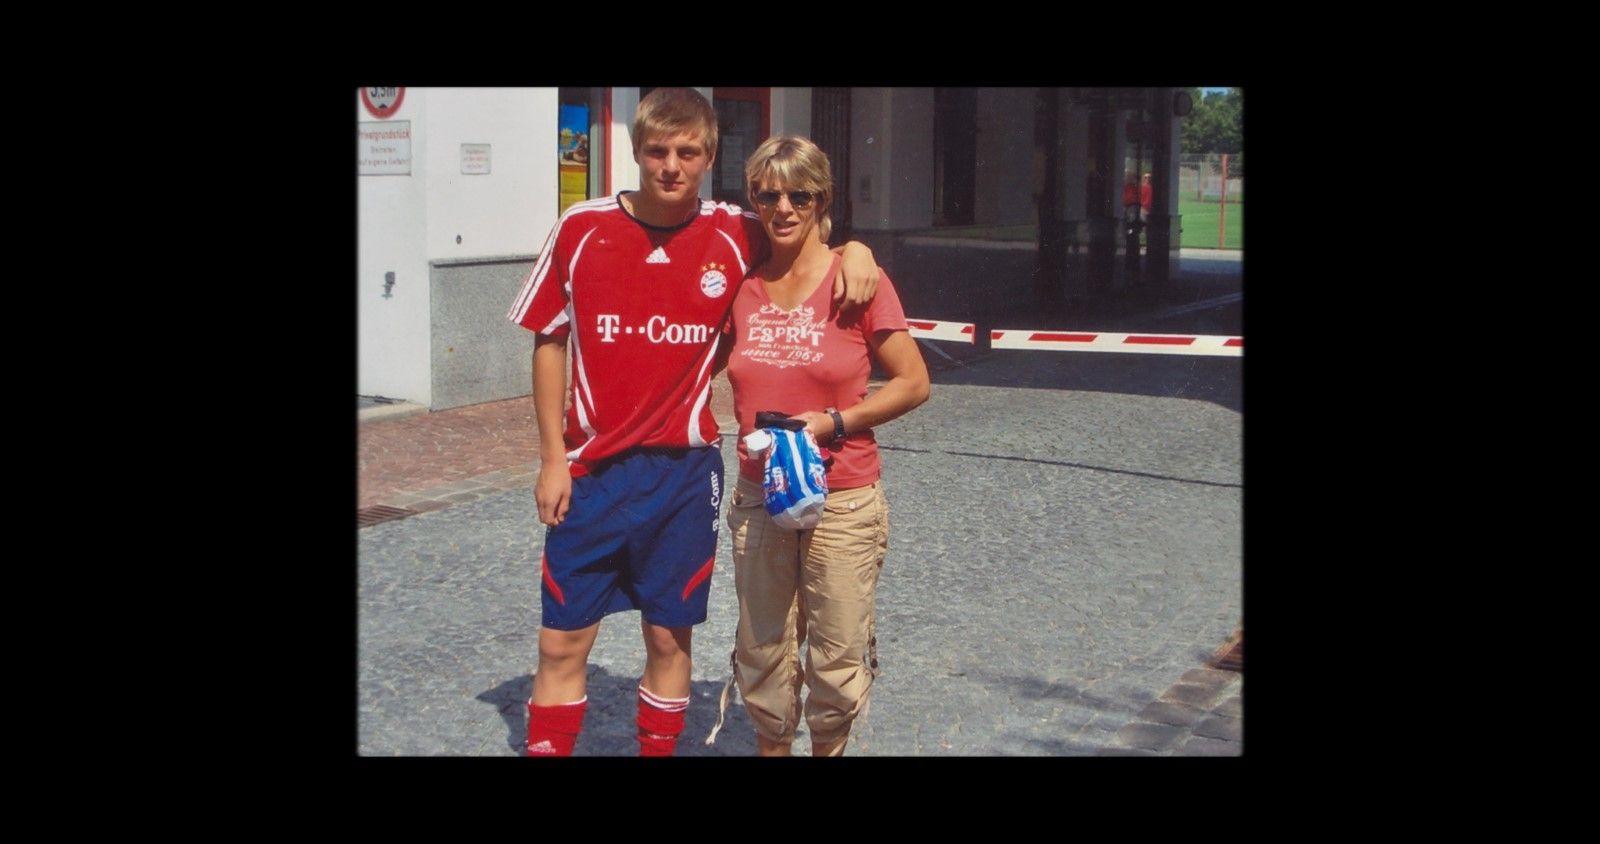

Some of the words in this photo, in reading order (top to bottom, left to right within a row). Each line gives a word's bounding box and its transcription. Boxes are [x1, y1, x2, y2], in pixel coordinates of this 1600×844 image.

[747, 326, 824, 347] ESPRIT
[741, 348, 780, 358] since
[786, 350, 824, 362] 1968
